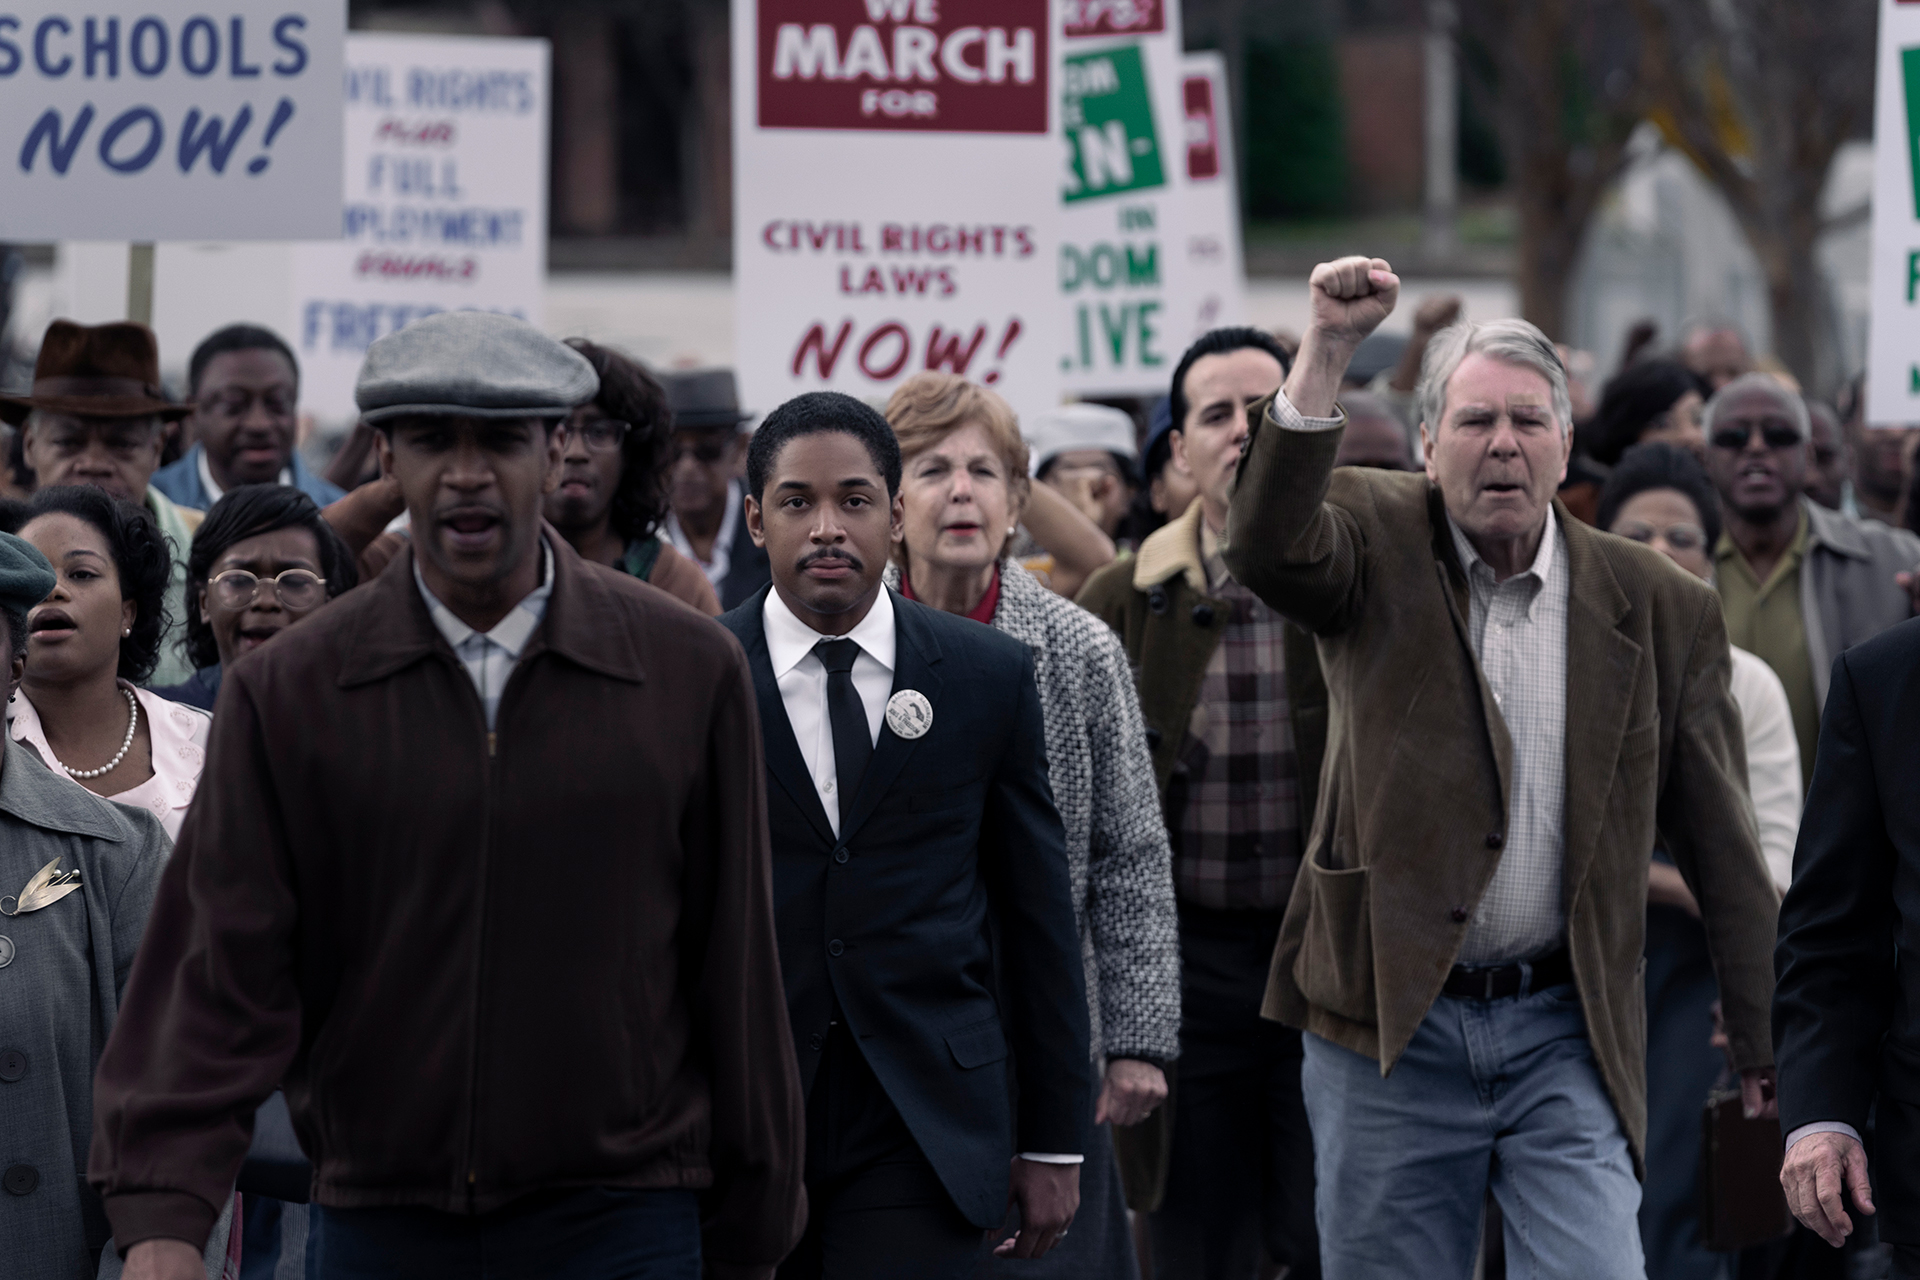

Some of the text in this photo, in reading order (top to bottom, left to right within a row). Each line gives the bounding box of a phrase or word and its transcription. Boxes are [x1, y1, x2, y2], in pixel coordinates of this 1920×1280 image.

[0, 14, 310, 78] SCHOOLS
[772, 23, 1037, 84] MARCH
[407, 67, 533, 114] RIGHTS
[860, 87, 939, 118] FOR
[18, 97, 296, 176] NOW!
[367, 155, 463, 197] FULL
[763, 220, 1035, 256] CIVIL RIGHTS
[838, 263, 956, 297] LAWS
[791, 317, 1023, 384] NOW!
[1061, 301, 1168, 371] IVE
